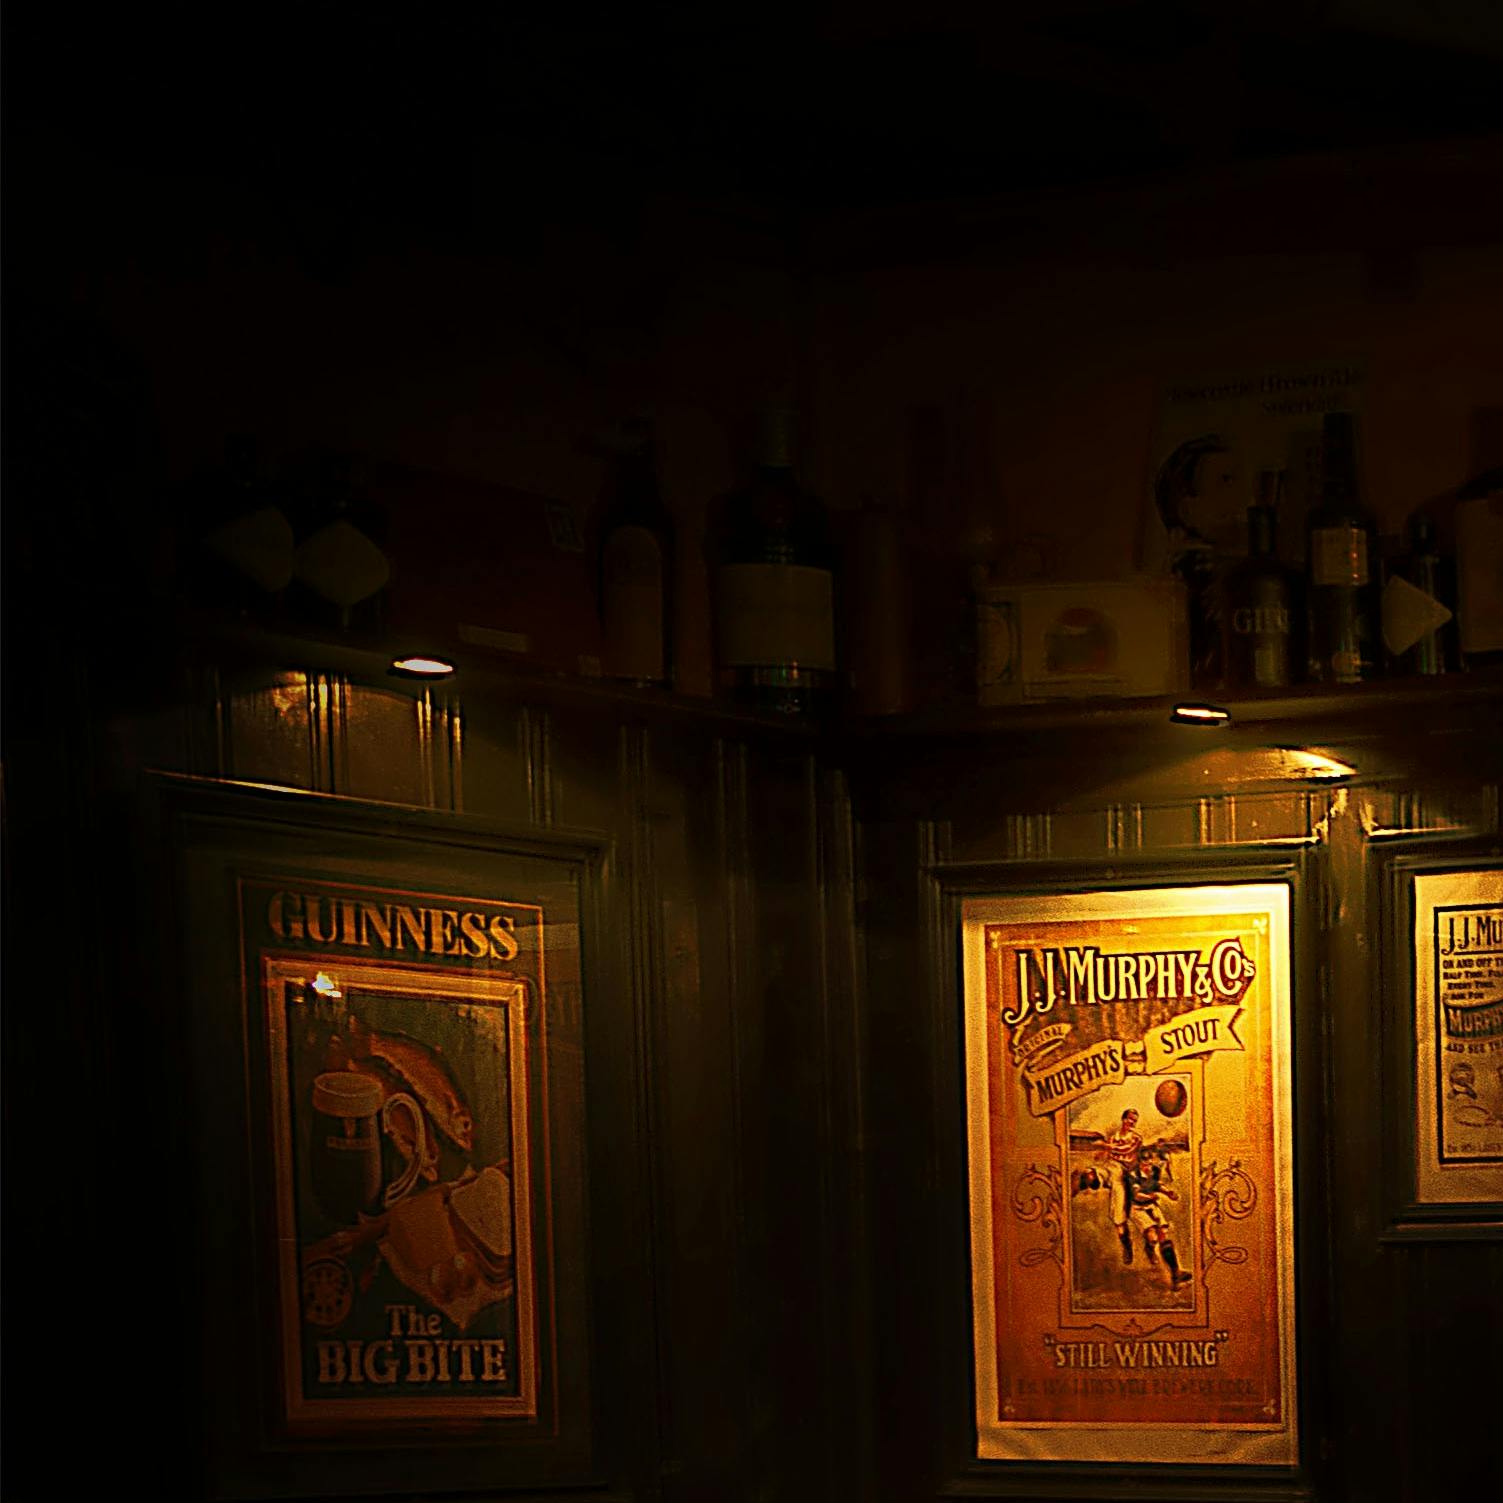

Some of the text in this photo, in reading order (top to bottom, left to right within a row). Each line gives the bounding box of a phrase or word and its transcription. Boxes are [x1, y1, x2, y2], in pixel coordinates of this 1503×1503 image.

[266, 890, 519, 962] GUINNESS
[1035, 1018, 1222, 1104] MURPHY'S STOUT
[383, 1303, 444, 1340] The
[315, 1336, 509, 1386] BIG BITE
